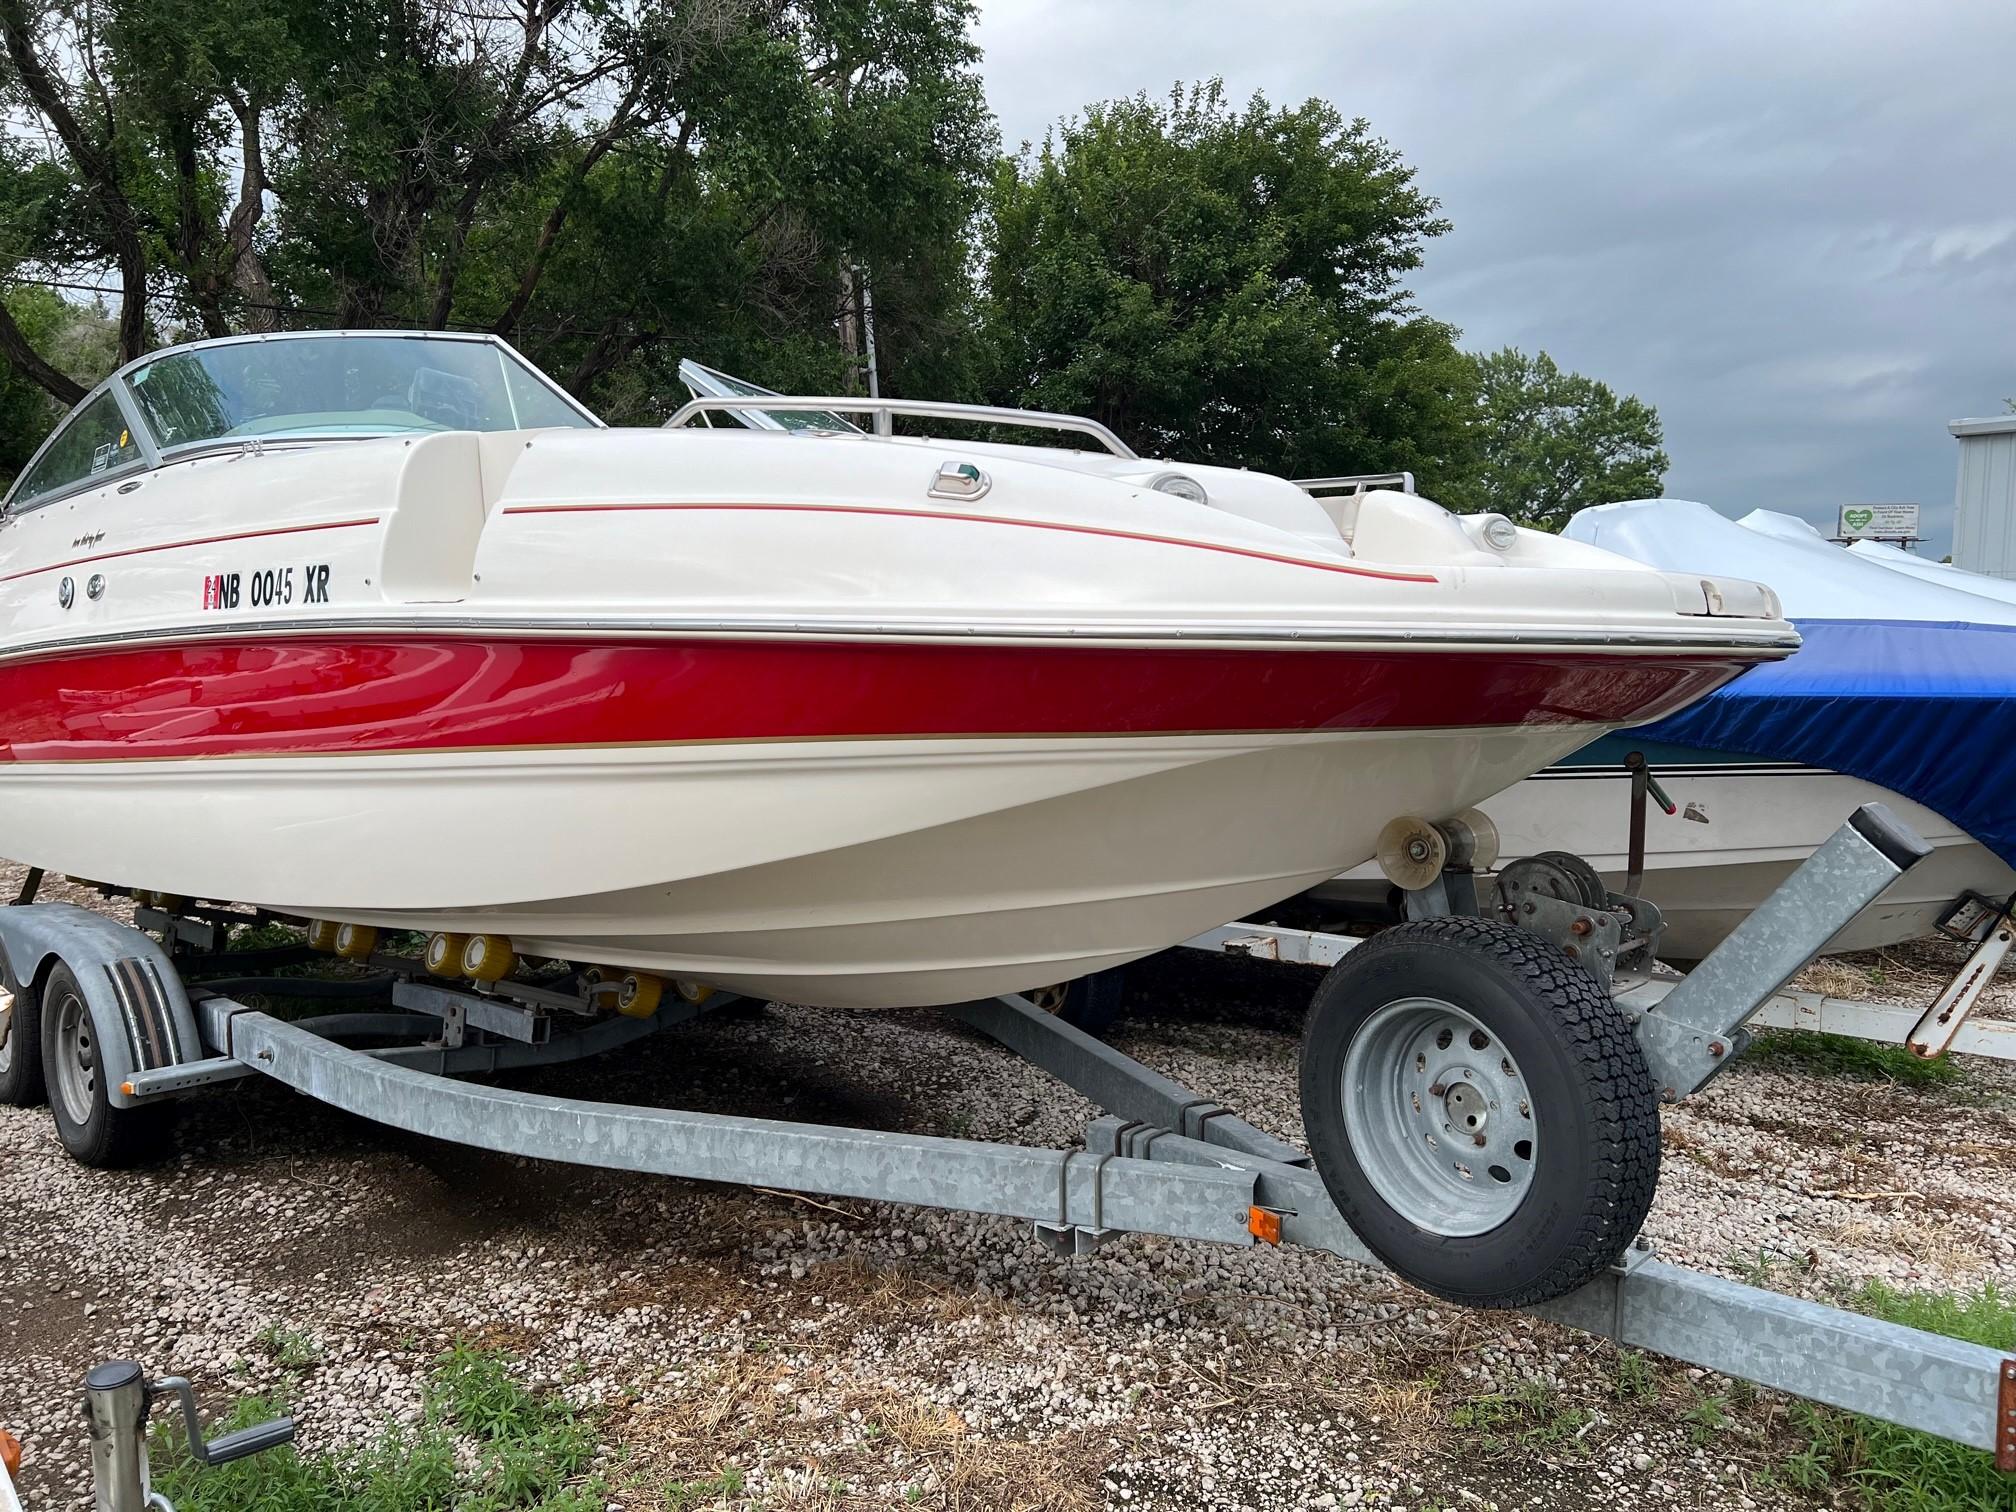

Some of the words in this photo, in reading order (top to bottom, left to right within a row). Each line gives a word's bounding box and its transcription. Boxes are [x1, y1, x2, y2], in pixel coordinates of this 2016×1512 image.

[218, 573, 240, 610] NB
[251, 567, 293, 607] 0045
[304, 564, 330, 604] XR
